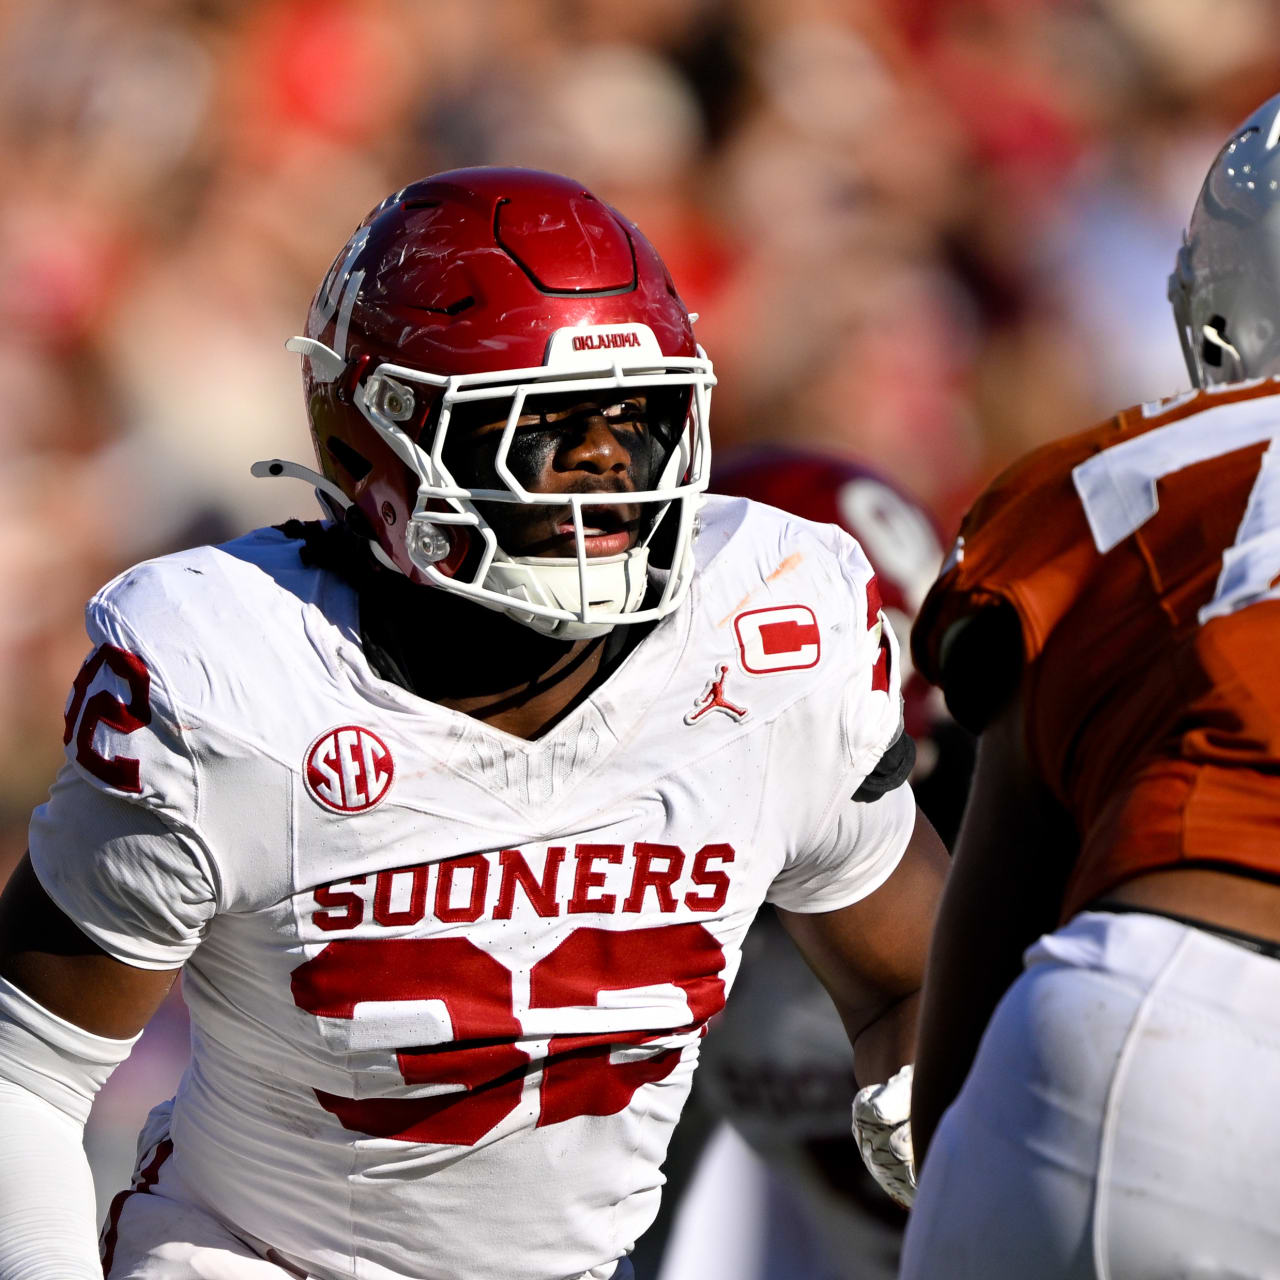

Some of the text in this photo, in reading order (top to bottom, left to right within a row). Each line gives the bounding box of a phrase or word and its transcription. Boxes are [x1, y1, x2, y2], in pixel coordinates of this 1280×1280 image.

[572, 332, 641, 351] OKLAHOMA
[735, 604, 820, 675] C
[308, 727, 393, 812] SEC
[312, 842, 735, 931] SOONERS
[290, 922, 726, 1146] 32
